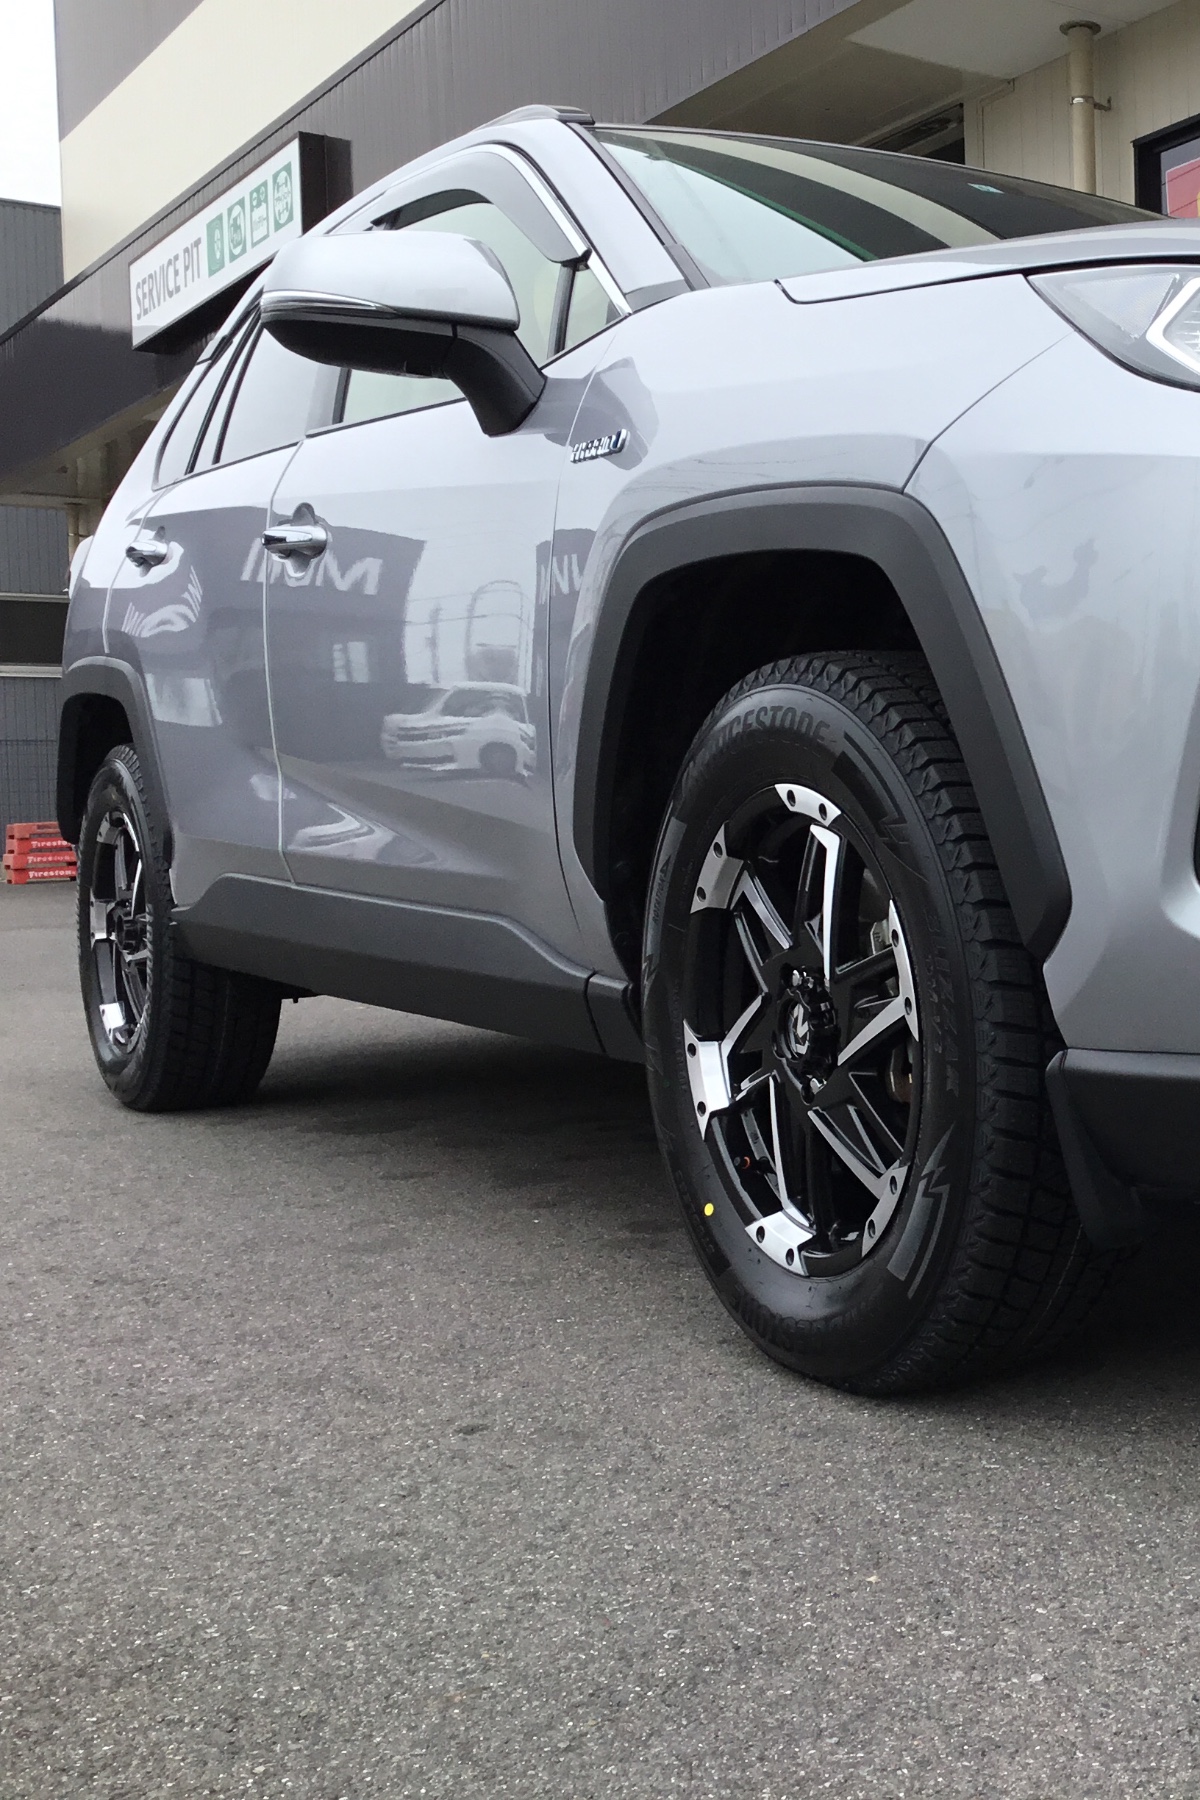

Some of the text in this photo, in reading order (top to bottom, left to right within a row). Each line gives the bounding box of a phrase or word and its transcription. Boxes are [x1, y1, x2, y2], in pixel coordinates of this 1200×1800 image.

[136, 237, 202, 321] SERVICE PIT
[682, 703, 832, 780] GESTONE
